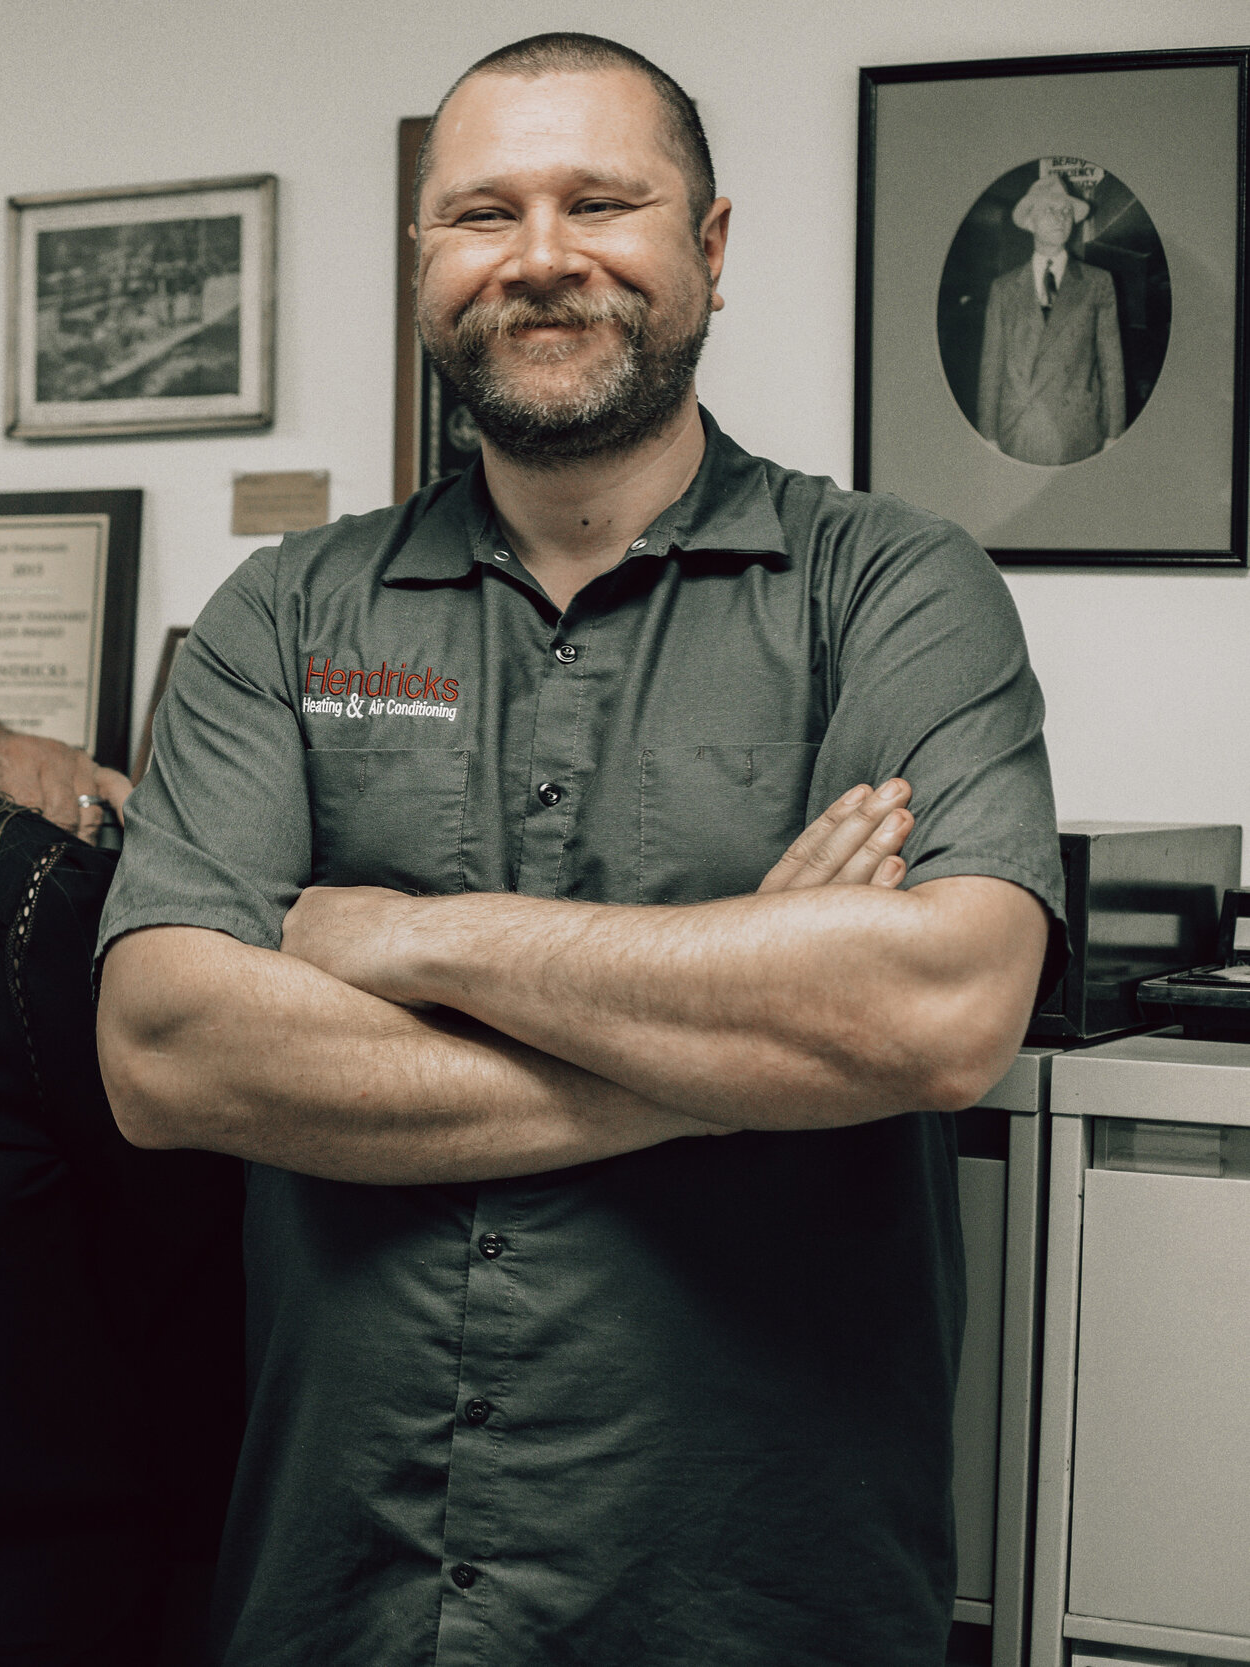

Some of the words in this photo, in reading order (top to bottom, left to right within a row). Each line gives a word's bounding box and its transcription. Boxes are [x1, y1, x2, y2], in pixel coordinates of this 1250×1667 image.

[305, 655, 459, 702] Hendricks
[302, 696, 343, 718] Heating
[346, 692, 365, 719] &
[368, 698, 385, 716] Air
[386, 699, 458, 722] Conditioning
